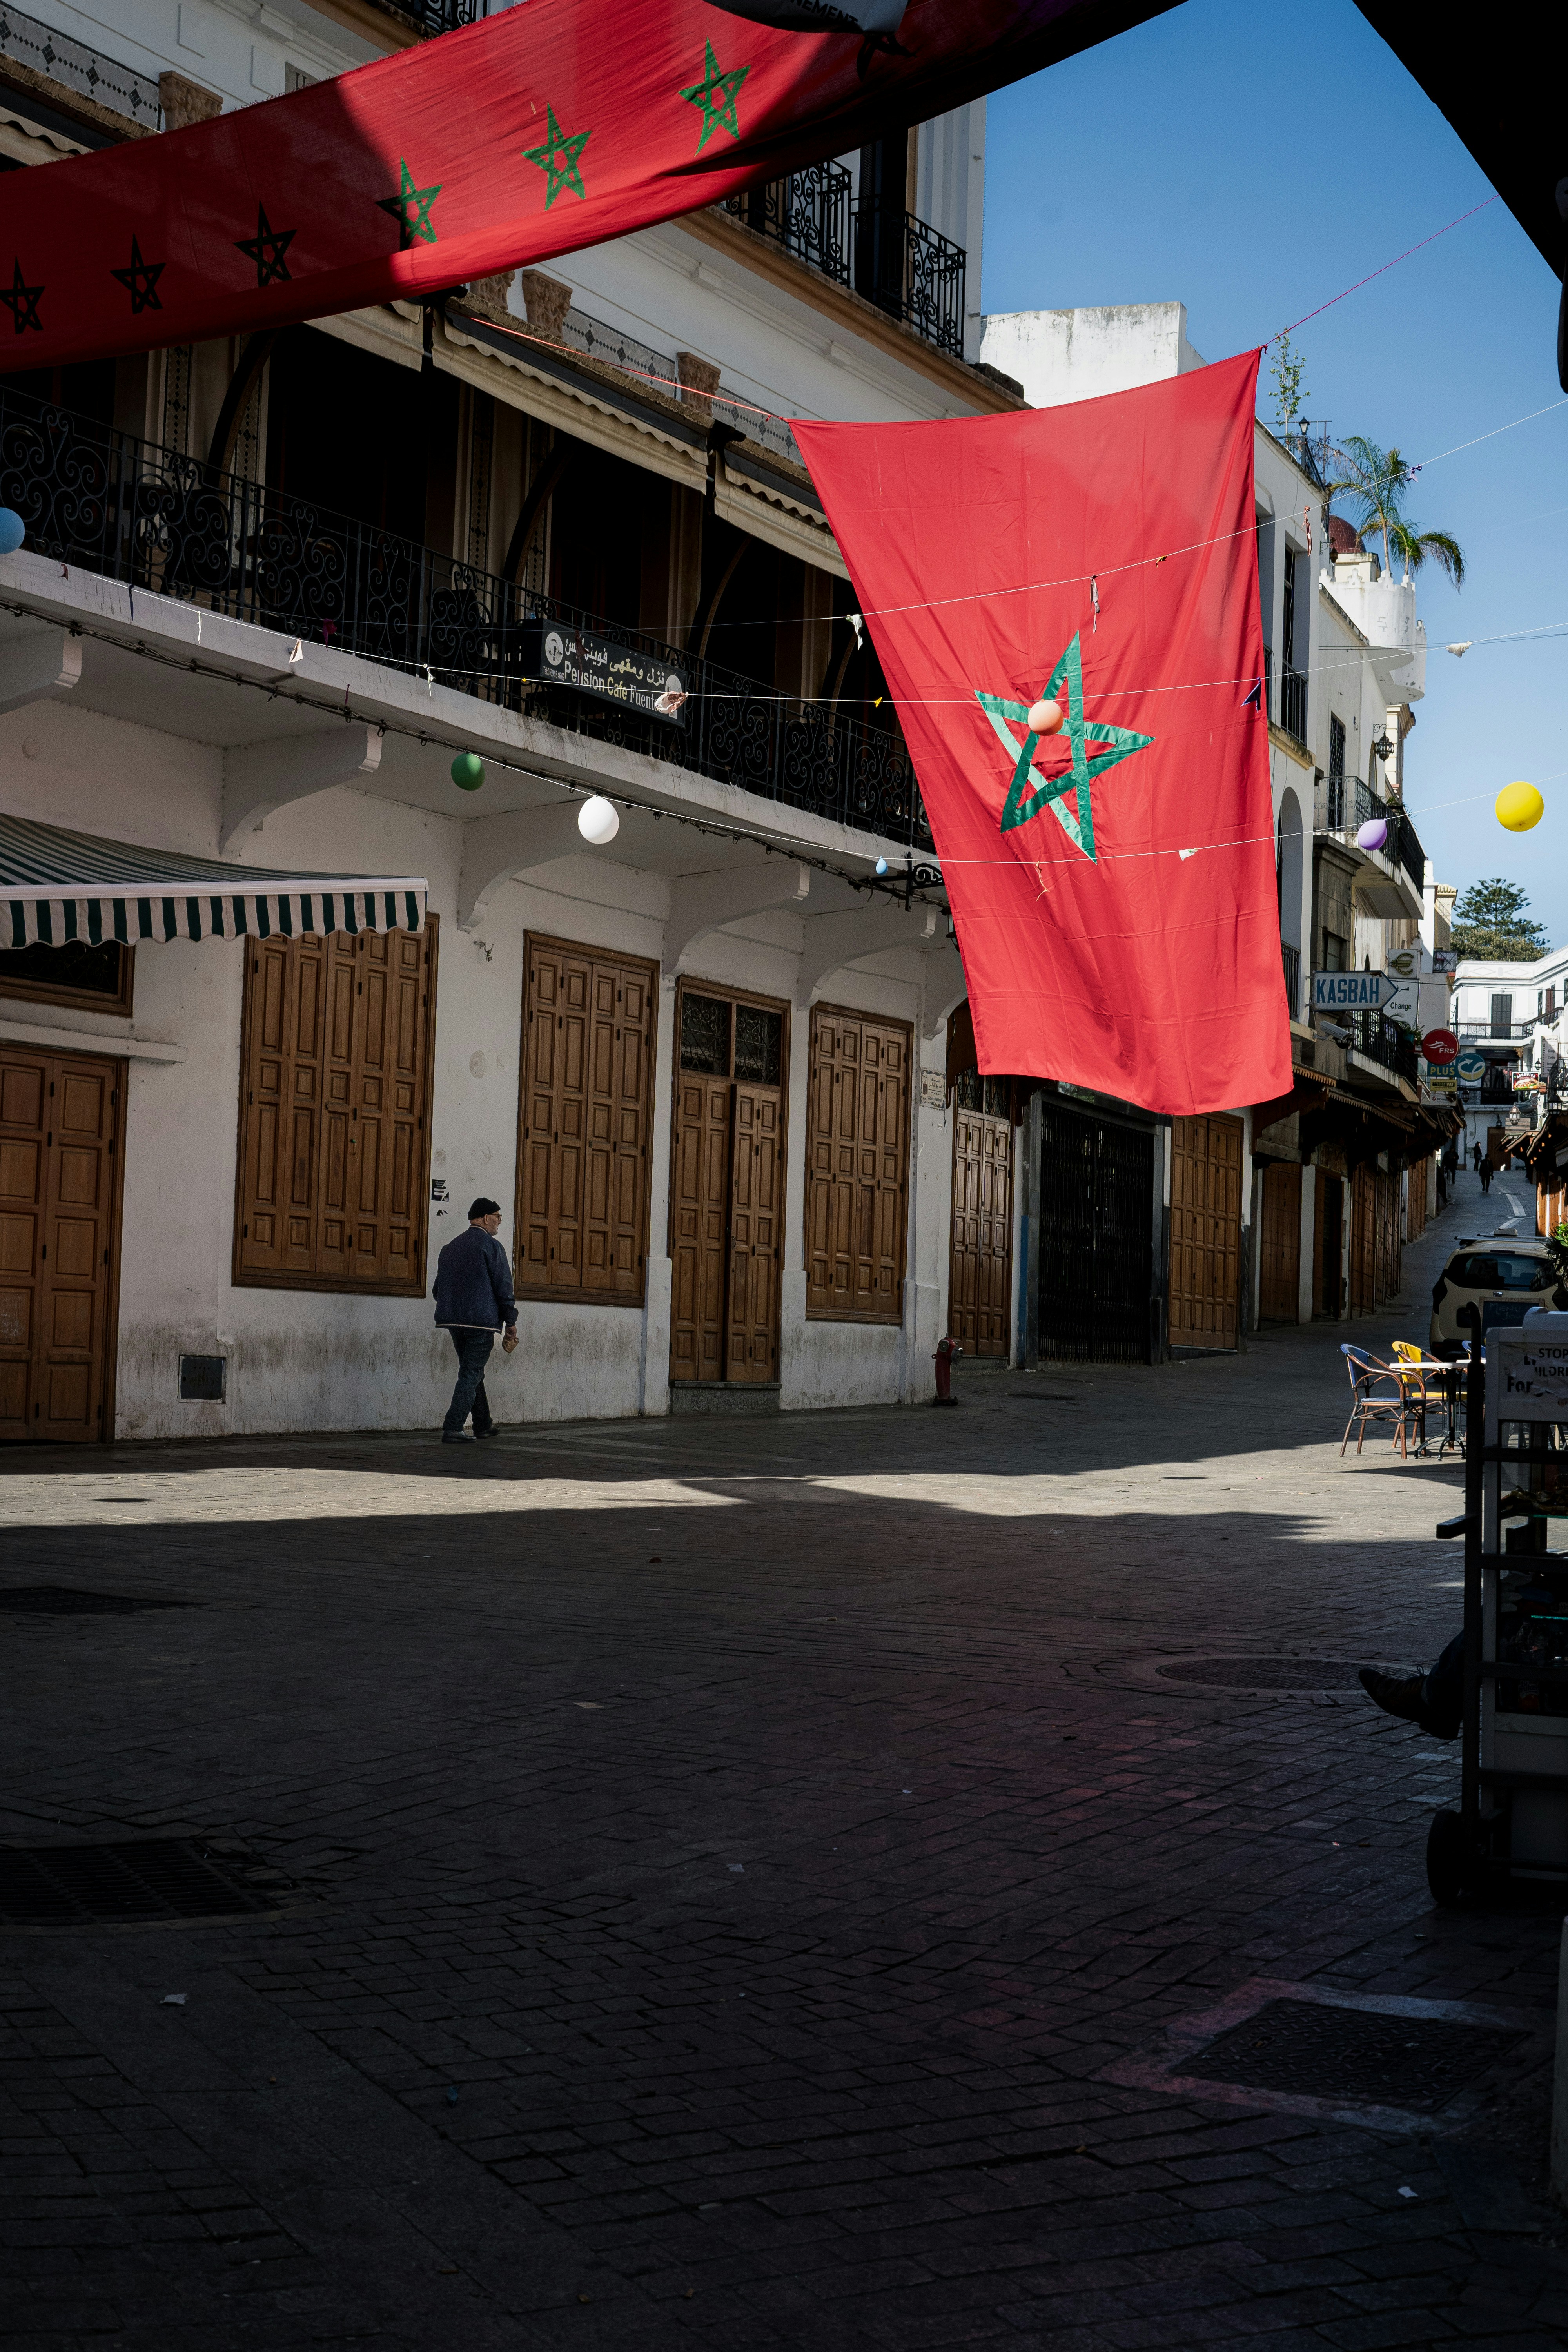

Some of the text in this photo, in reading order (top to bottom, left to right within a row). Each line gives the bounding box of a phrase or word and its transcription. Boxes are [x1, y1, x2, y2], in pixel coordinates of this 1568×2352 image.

[610, 658, 643, 680] ومقهى
[647, 668, 664, 686] نزل
[564, 660, 604, 692] Pension
[608, 677, 627, 700] Cafe
[1316, 978, 1379, 1004] KASBAH
[1390, 1002, 1412, 1011] Change
[1430, 1067, 1455, 1075] PLUS
[1539, 1348, 1568, 1358] STOP
